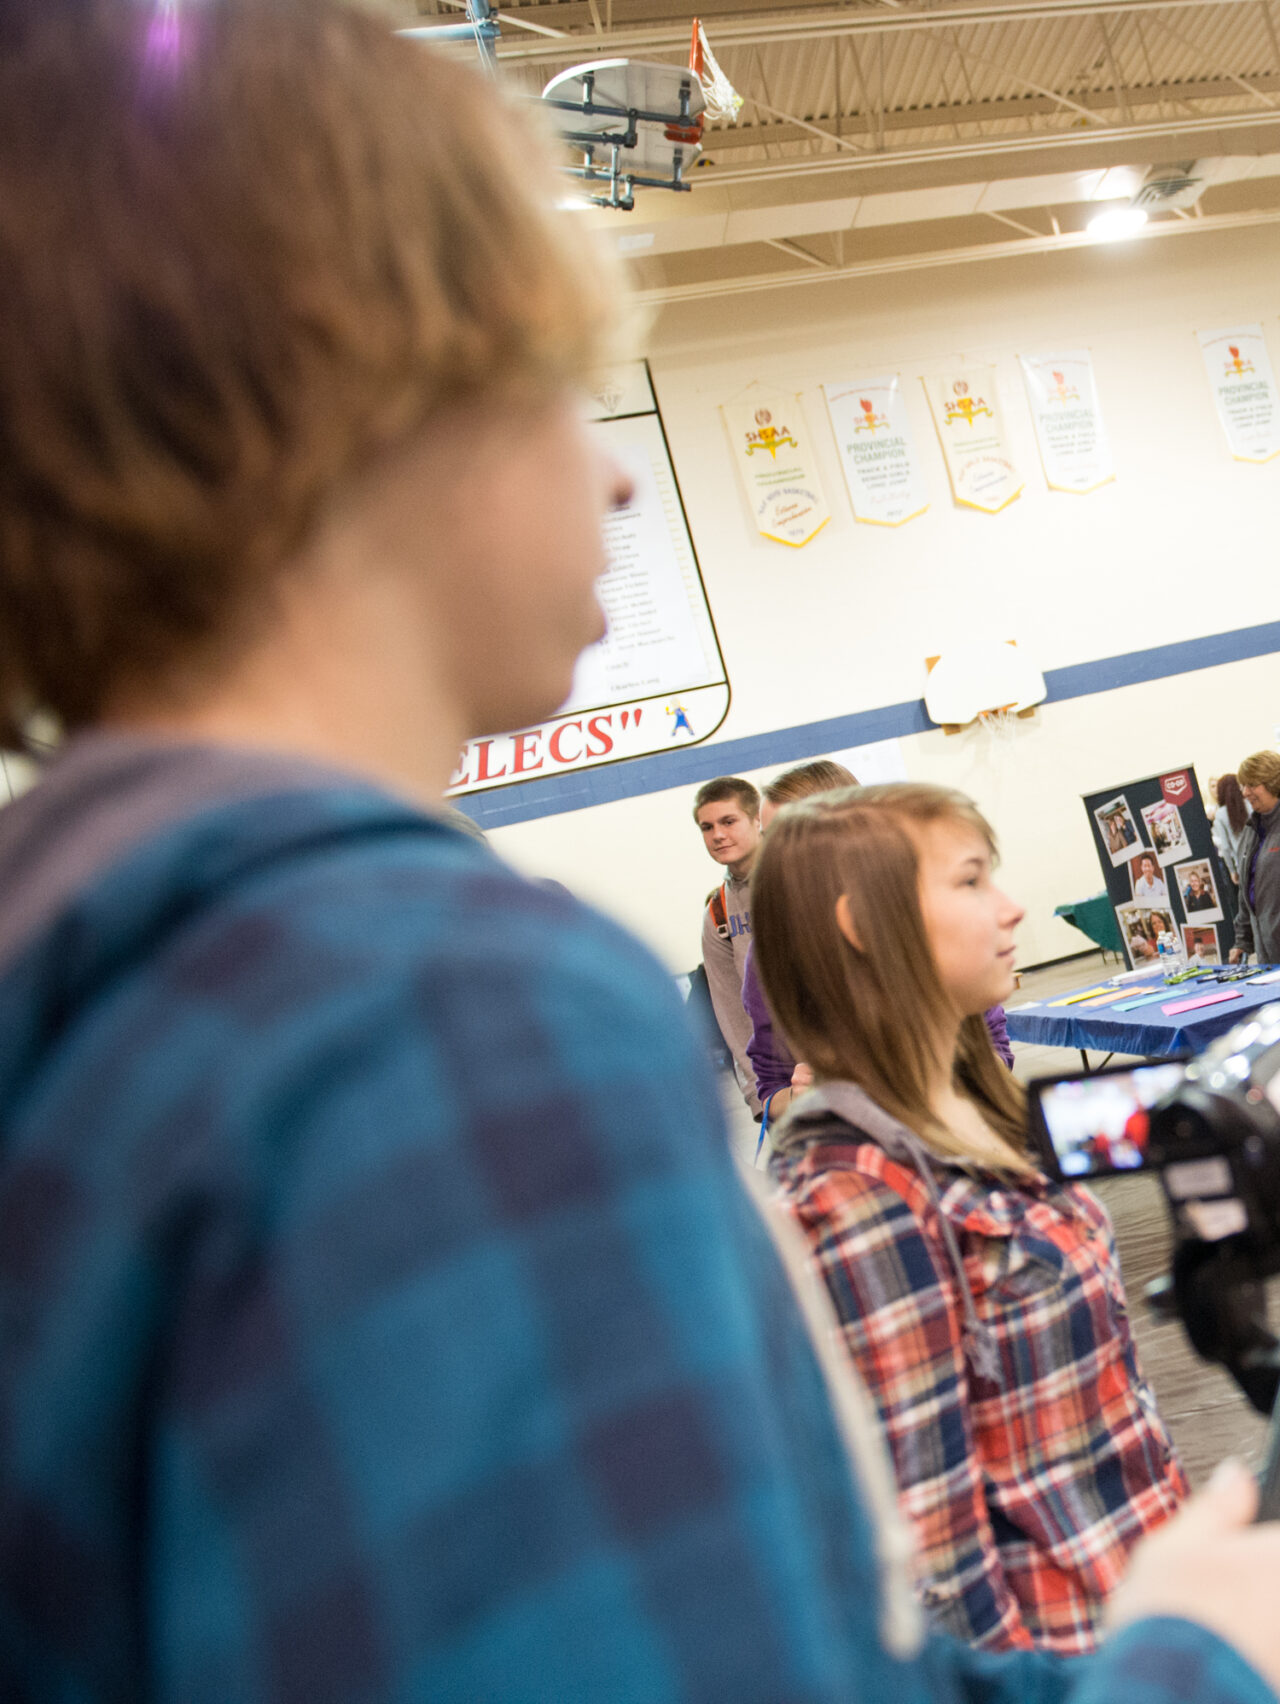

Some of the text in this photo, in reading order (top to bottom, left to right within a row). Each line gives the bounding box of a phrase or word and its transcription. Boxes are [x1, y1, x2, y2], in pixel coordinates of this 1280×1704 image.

[744, 425, 791, 443] SHSAA
[846, 436, 907, 454] PROVINCIAL
[853, 448, 906, 465] CHAMPION
